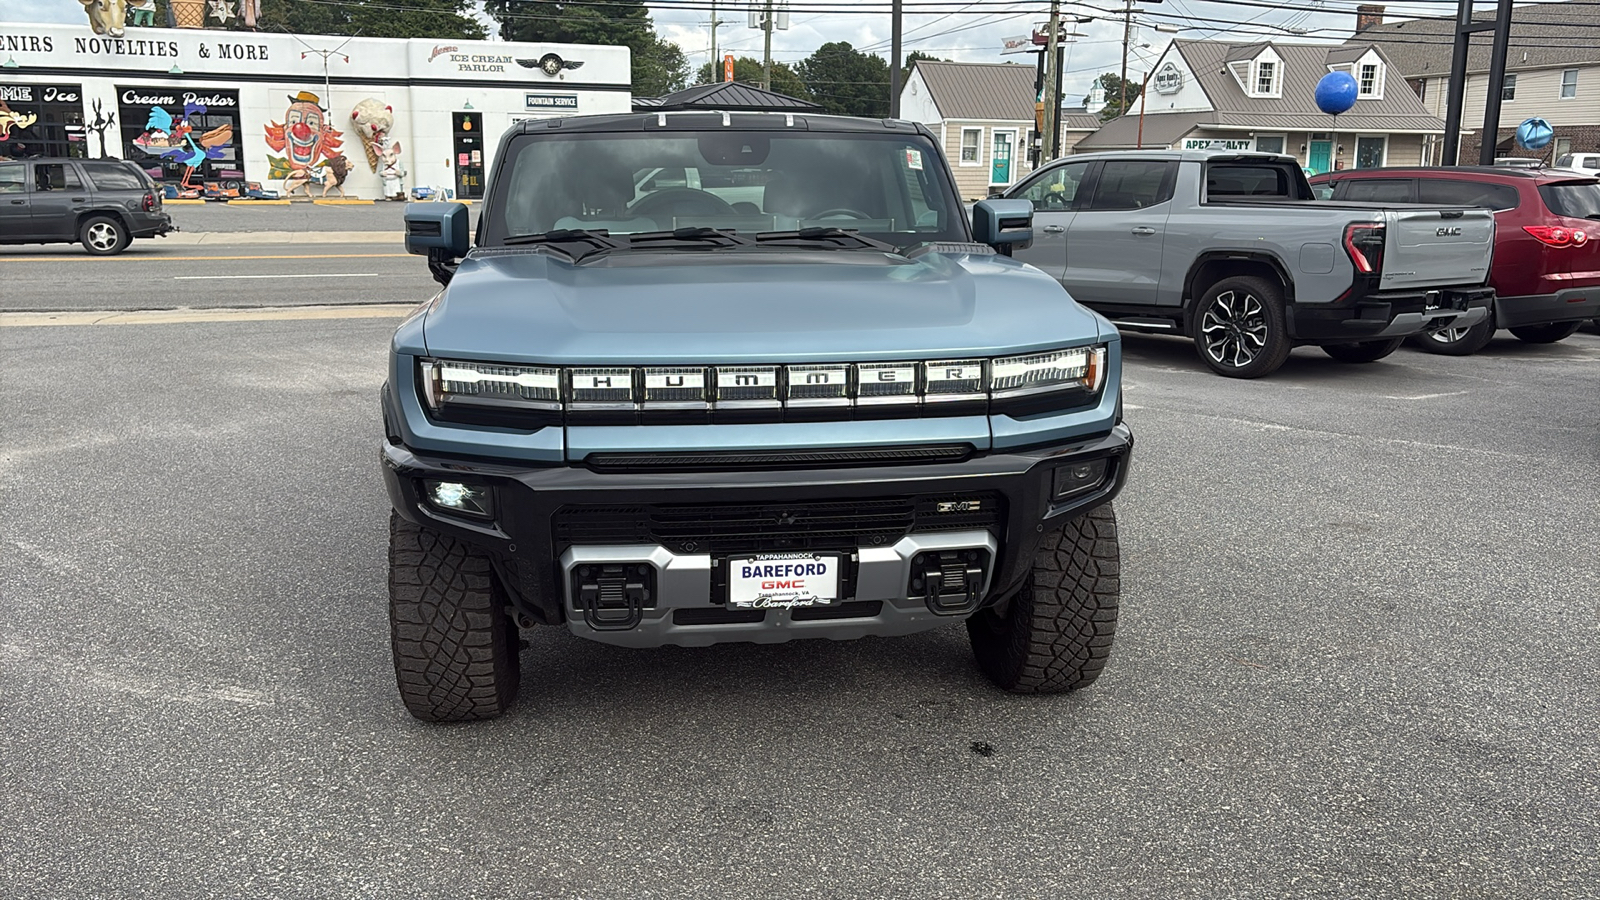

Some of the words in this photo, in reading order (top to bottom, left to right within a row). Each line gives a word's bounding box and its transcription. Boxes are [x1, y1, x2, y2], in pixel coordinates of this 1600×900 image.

[74, 37, 179, 58] NOVELTIES
[199, 43, 210, 59] &
[217, 43, 269, 60] MORE
[450, 54, 469, 62] ICE
[471, 55, 512, 64] CREAM
[458, 64, 505, 72] PARLOR
[725, 57, 733, 82] ACM
[43, 87, 79, 102] Ice
[122, 90, 176, 105] Cream
[182, 91, 236, 107] Parlor
[528, 97, 554, 105] FOUNTAIN
[555, 97, 576, 106] SERVICE
[1186, 140, 1211, 150] APEX
[1213, 140, 1250, 150] ALTY
[1436, 227, 1461, 237] GMC
[937, 500, 981, 512] GMC
[742, 563, 827, 578] BAREFORD
[762, 579, 805, 590] GMC
[753, 596, 816, 610] Bareford
